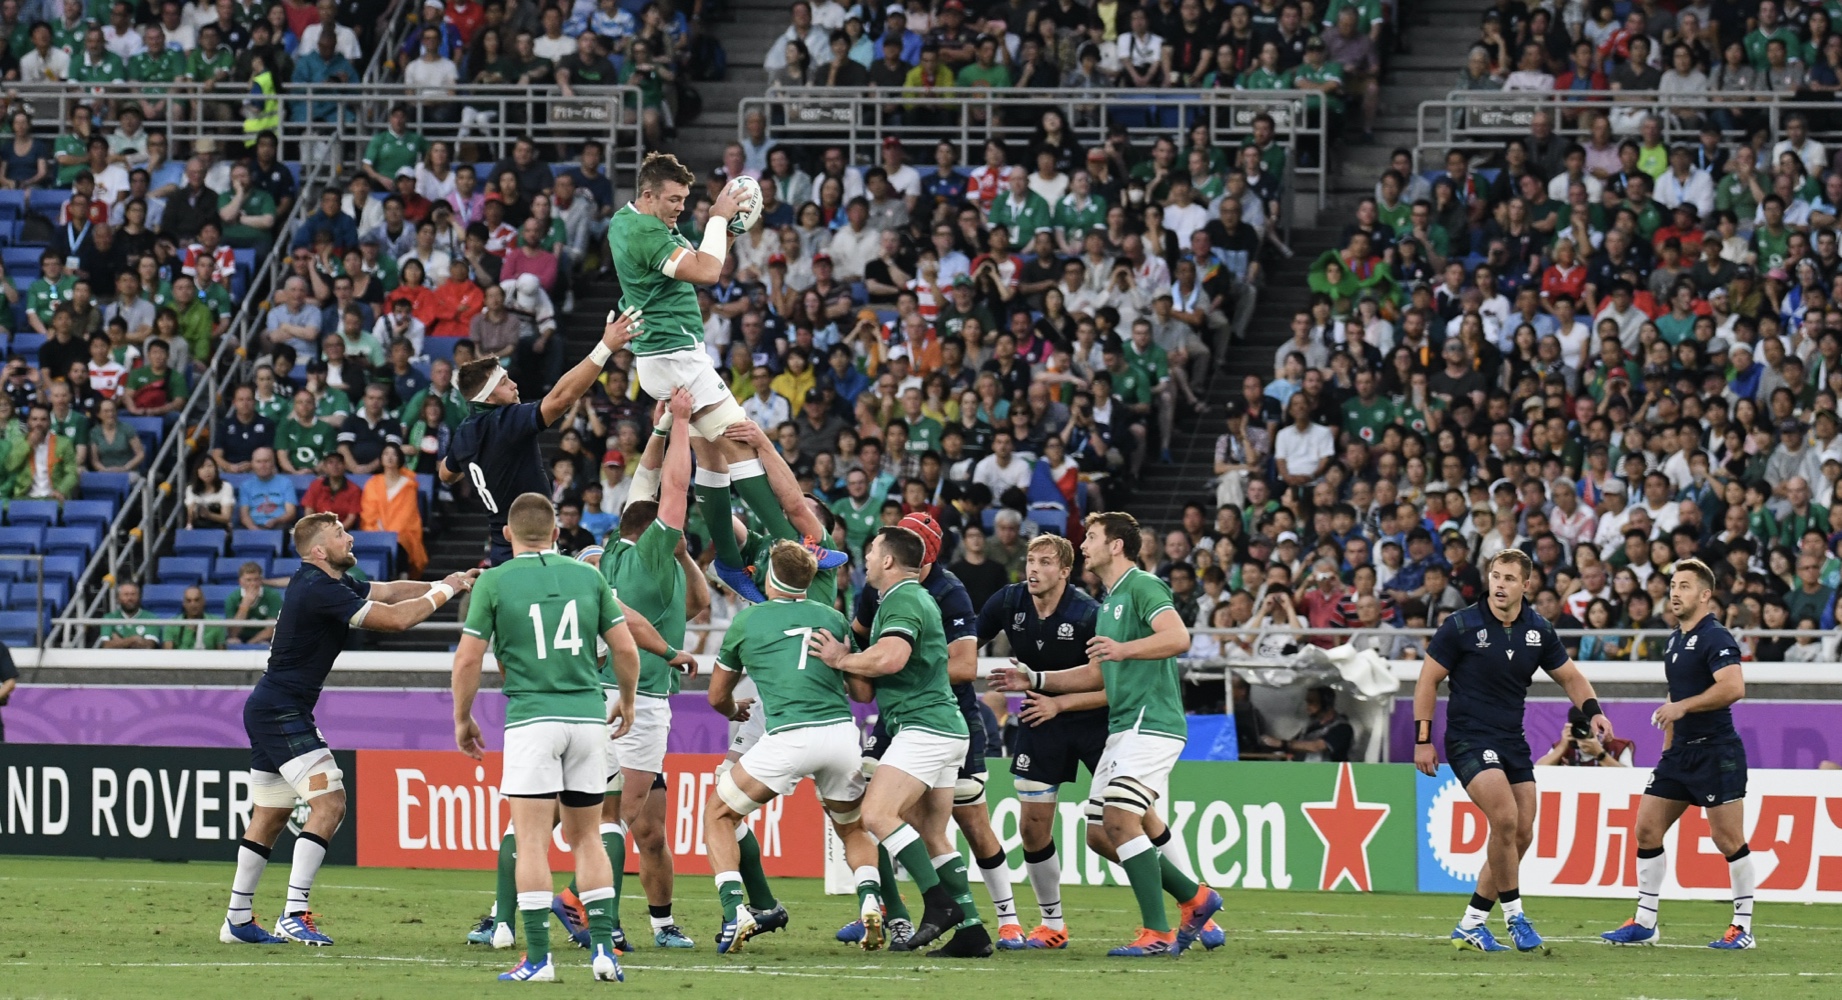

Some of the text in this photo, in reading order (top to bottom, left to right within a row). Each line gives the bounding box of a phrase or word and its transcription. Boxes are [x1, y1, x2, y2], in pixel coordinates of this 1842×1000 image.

[468, 461, 499, 515] 8
[528, 598, 584, 660] 14
[782, 626, 813, 670] 7
[0, 765, 254, 841] ND ROVER
[673, 771, 784, 859] BER
[942, 764, 1292, 890] enken
